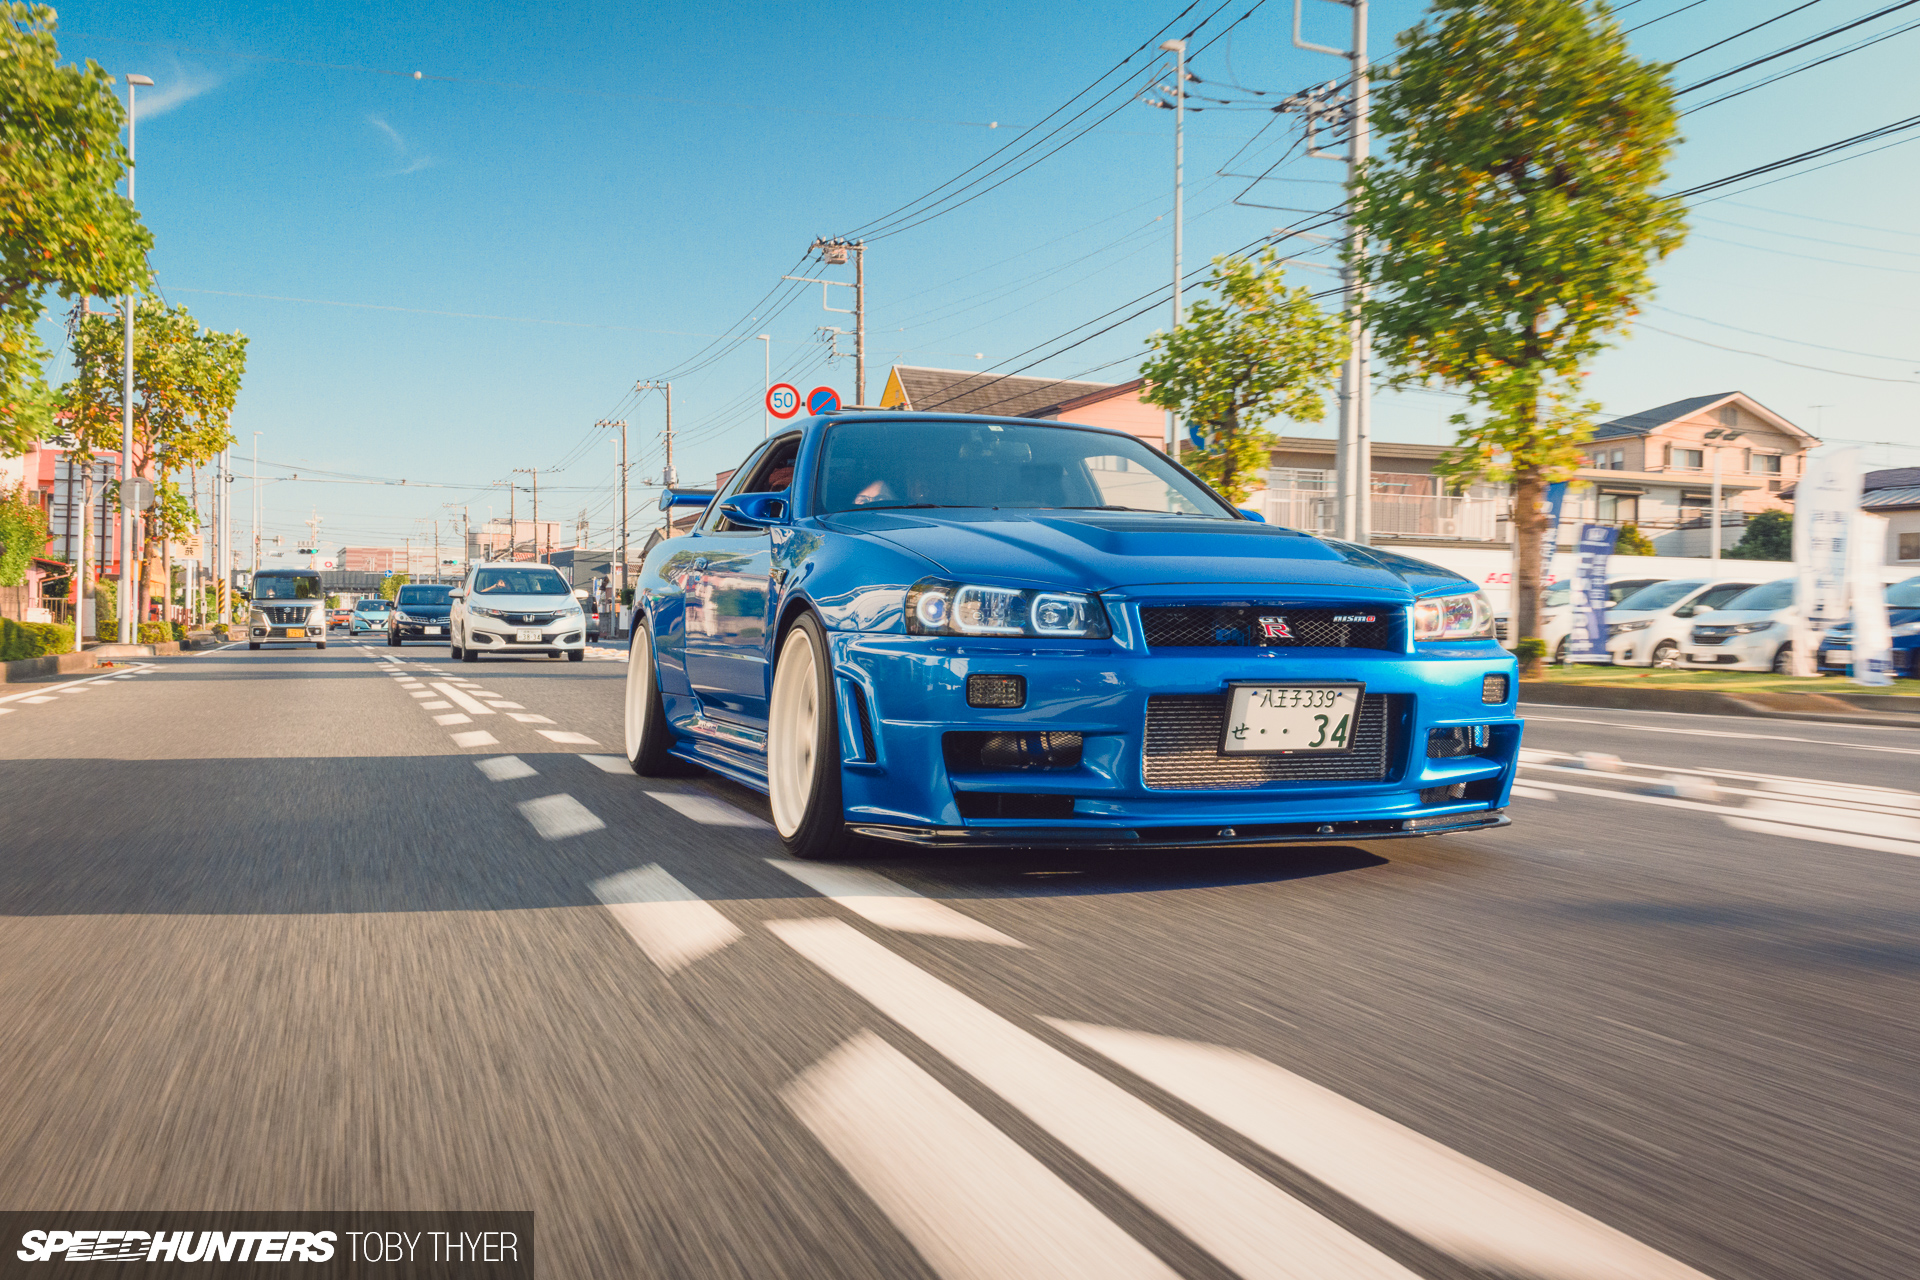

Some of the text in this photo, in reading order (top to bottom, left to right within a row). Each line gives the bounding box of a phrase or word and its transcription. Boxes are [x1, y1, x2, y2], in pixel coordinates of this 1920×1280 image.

[774, 392, 793, 408] 50
[1231, 714, 1350, 748] せ 34
